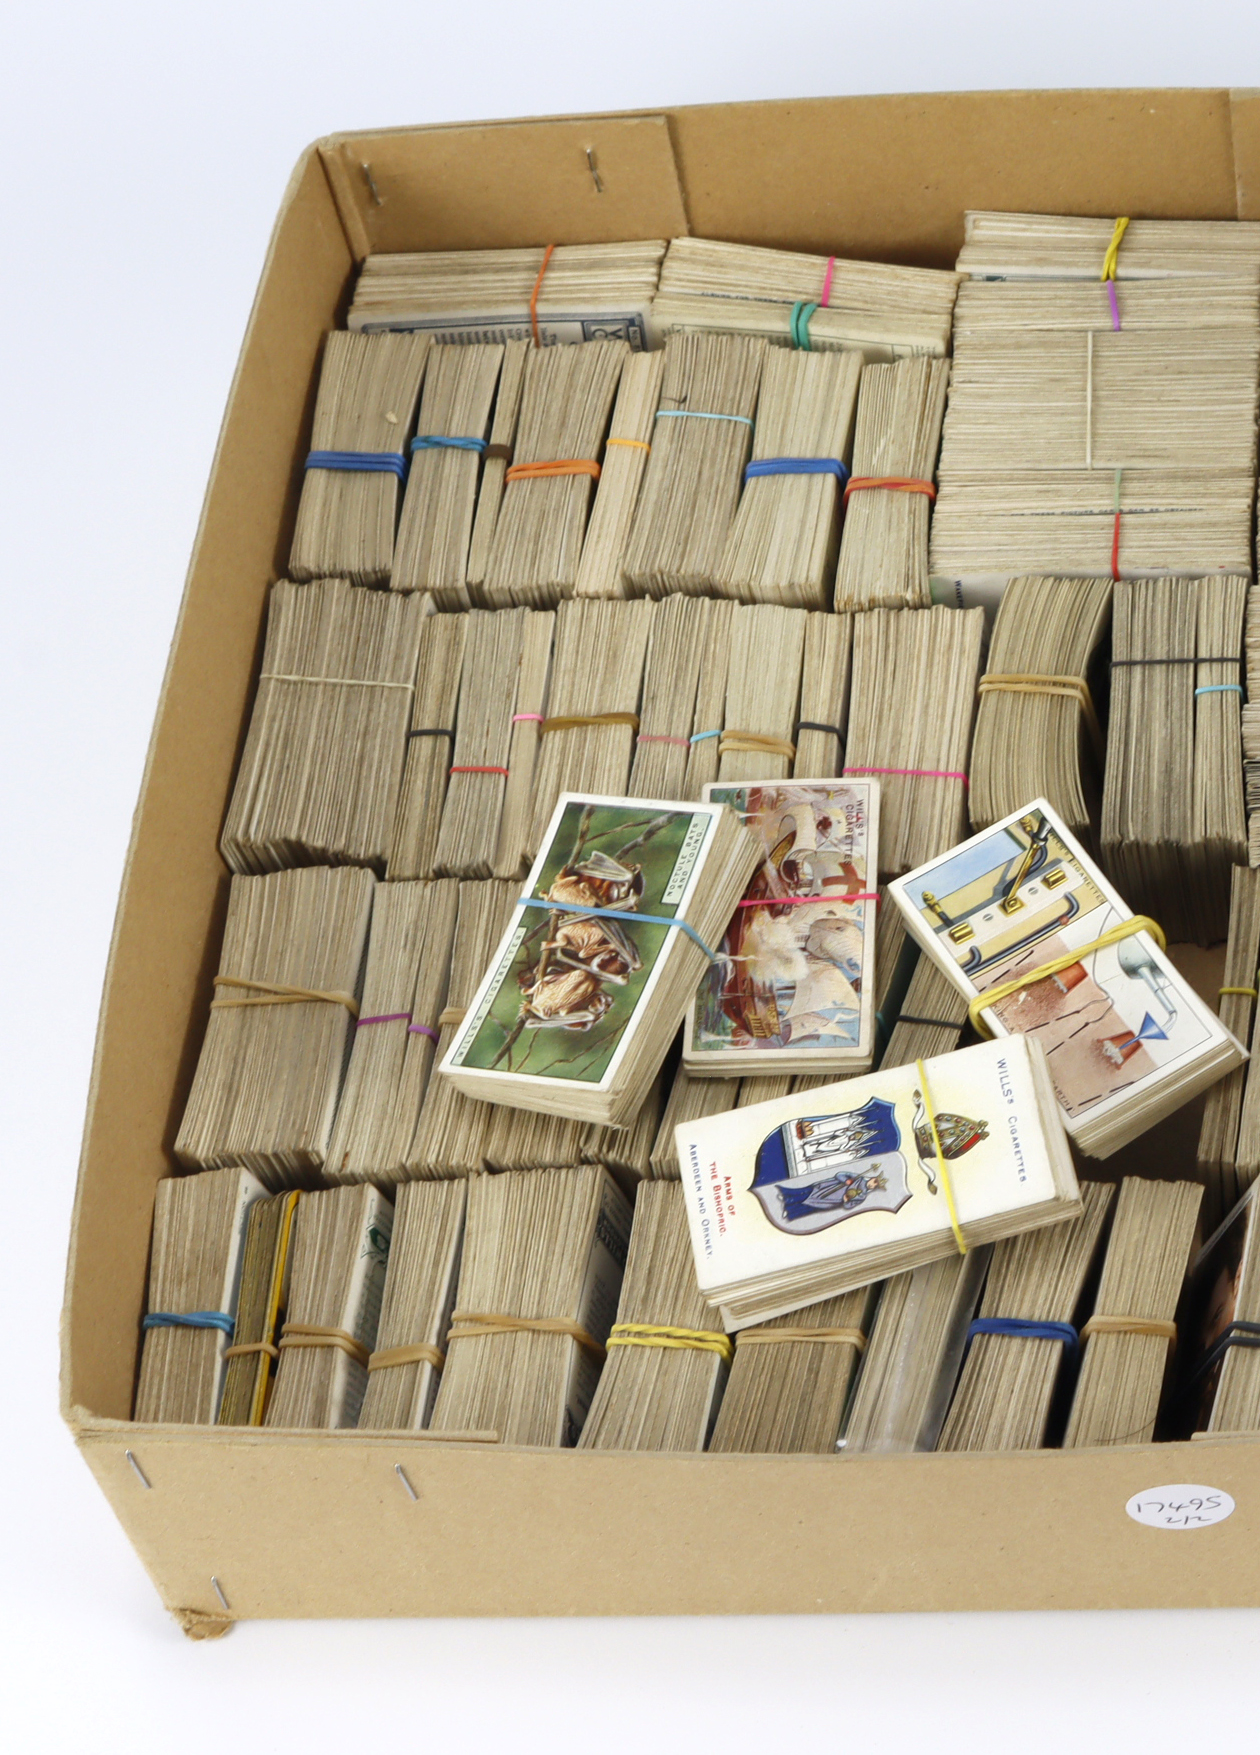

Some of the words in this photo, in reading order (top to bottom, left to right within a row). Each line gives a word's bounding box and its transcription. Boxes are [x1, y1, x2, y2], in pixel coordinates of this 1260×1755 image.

[665, 852, 688, 898] NOCTULE
[684, 821, 700, 851] BATS
[677, 870, 689, 892] AND
[688, 1143, 704, 1195] ABERDEEN
[697, 1197, 706, 1216] AND
[708, 1161, 719, 1179] THE
[722, 1174, 734, 1202] ARMS
[726, 1204, 736, 1217] OF
[1136, 1495, 1222, 1513] 17495
